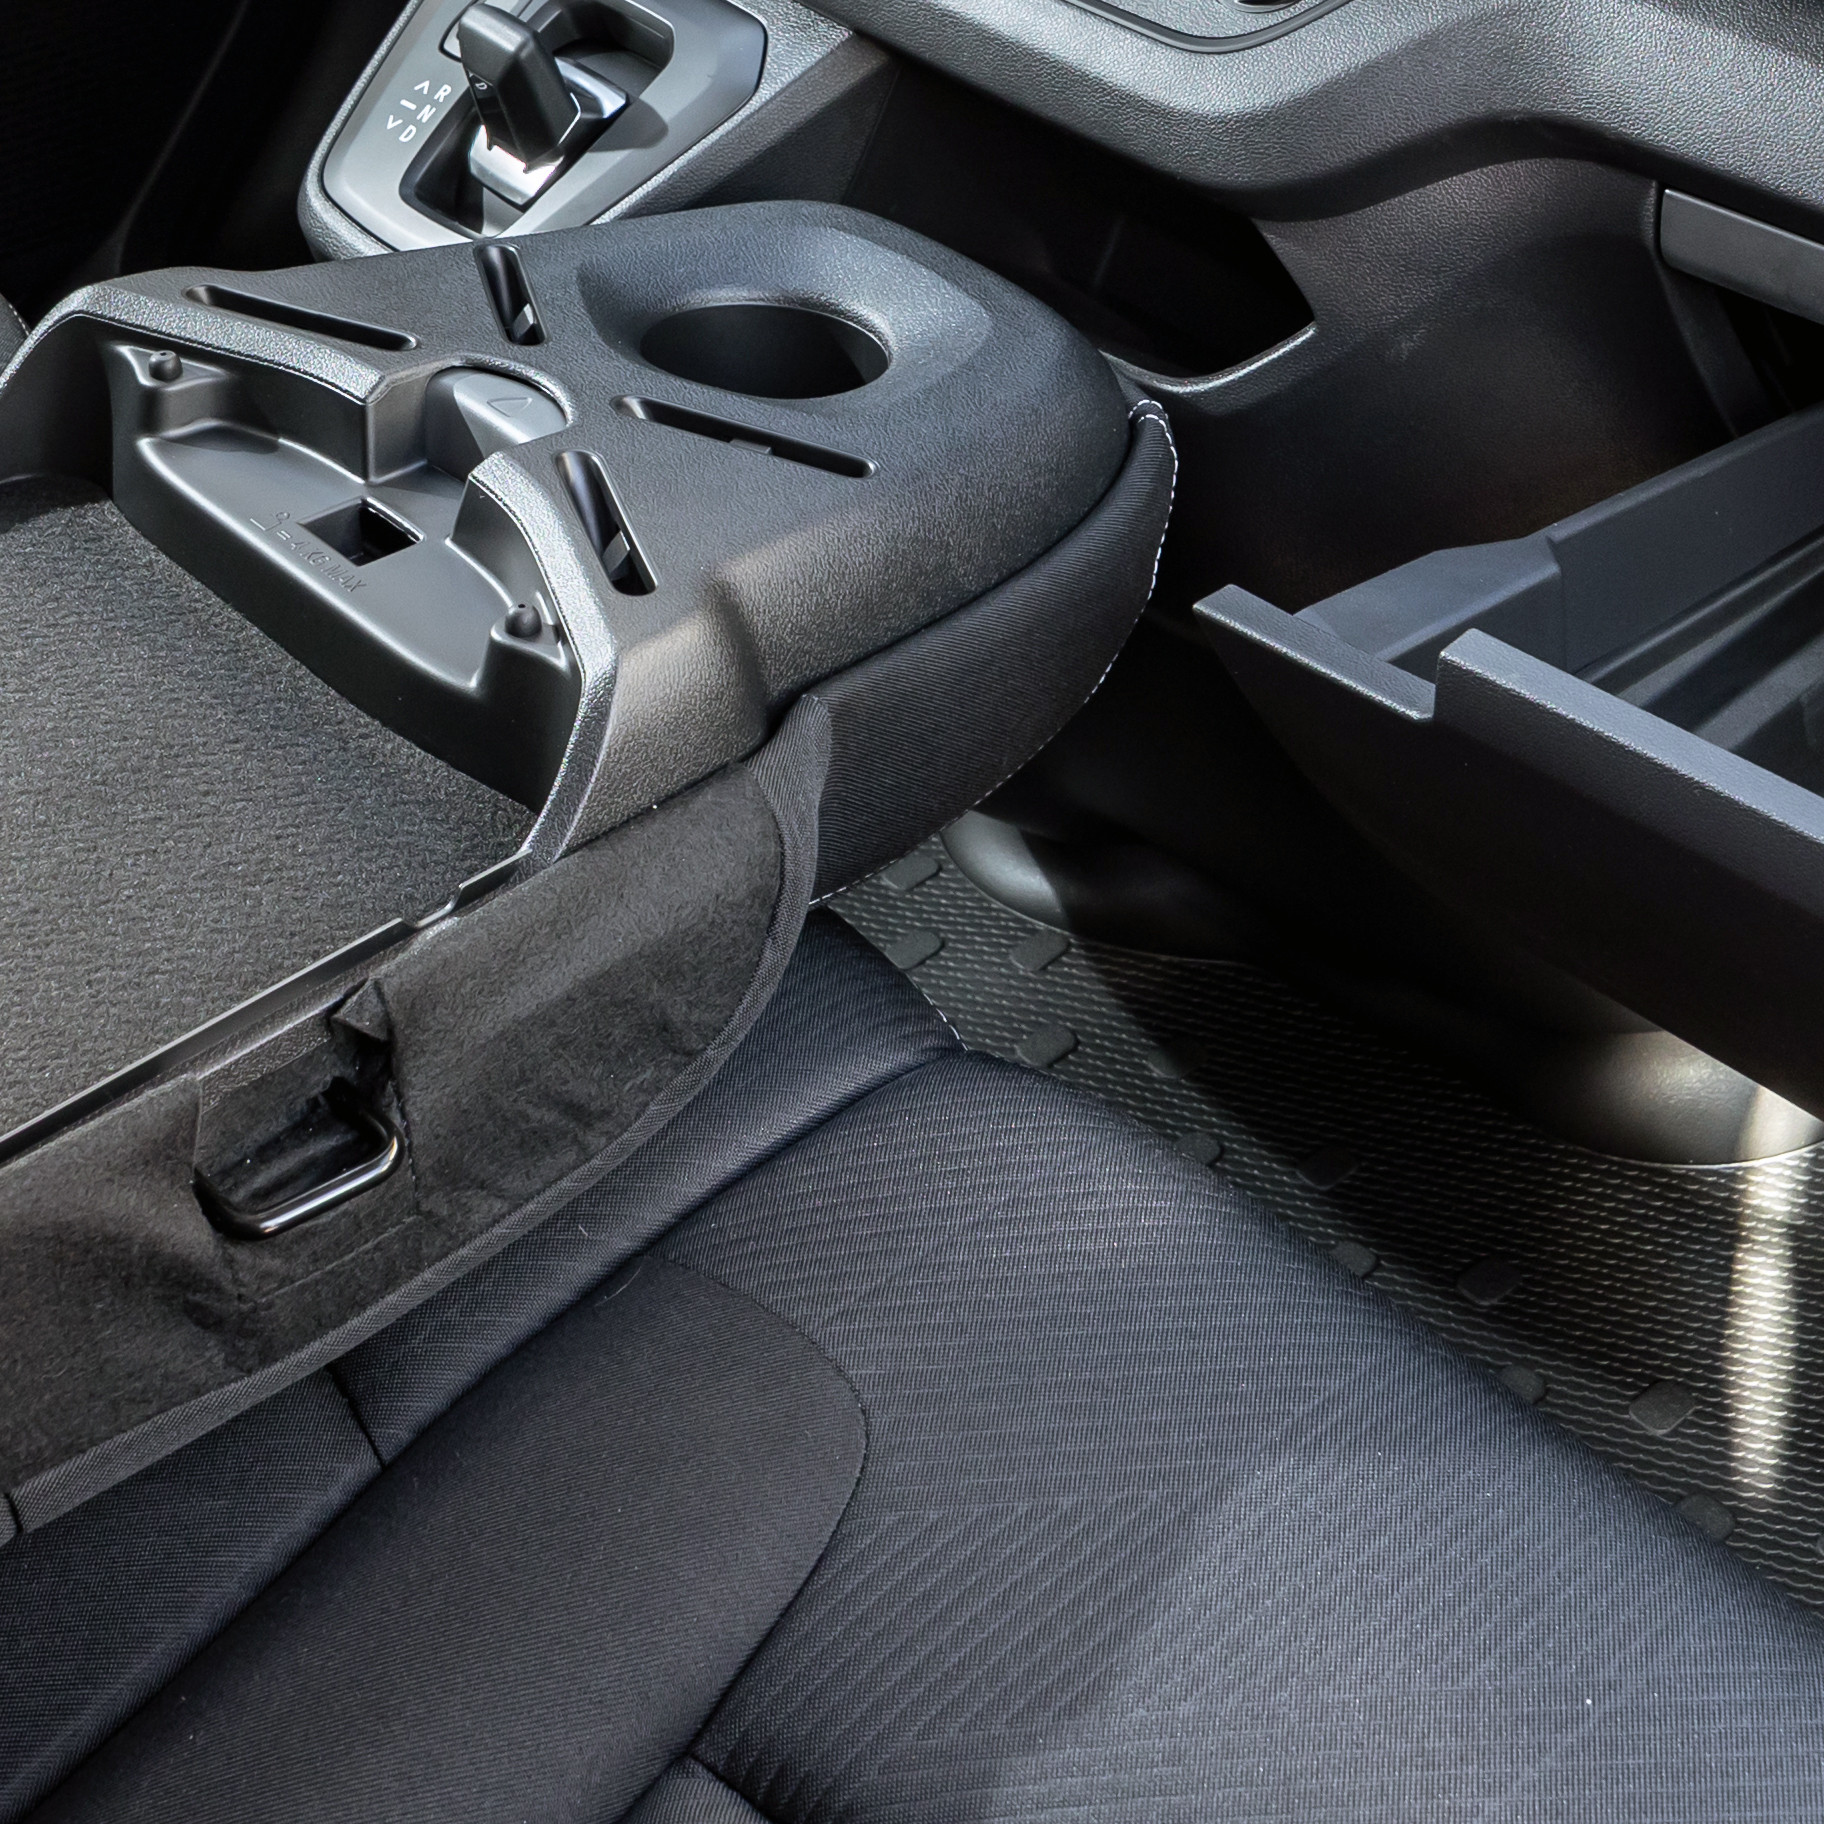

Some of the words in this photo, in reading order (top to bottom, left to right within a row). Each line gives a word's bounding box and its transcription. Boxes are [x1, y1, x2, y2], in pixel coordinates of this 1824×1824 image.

[433, 84, 452, 103] R
[416, 104, 436, 124] N
[398, 124, 417, 143] D
[321, 564, 367, 593] MAX
